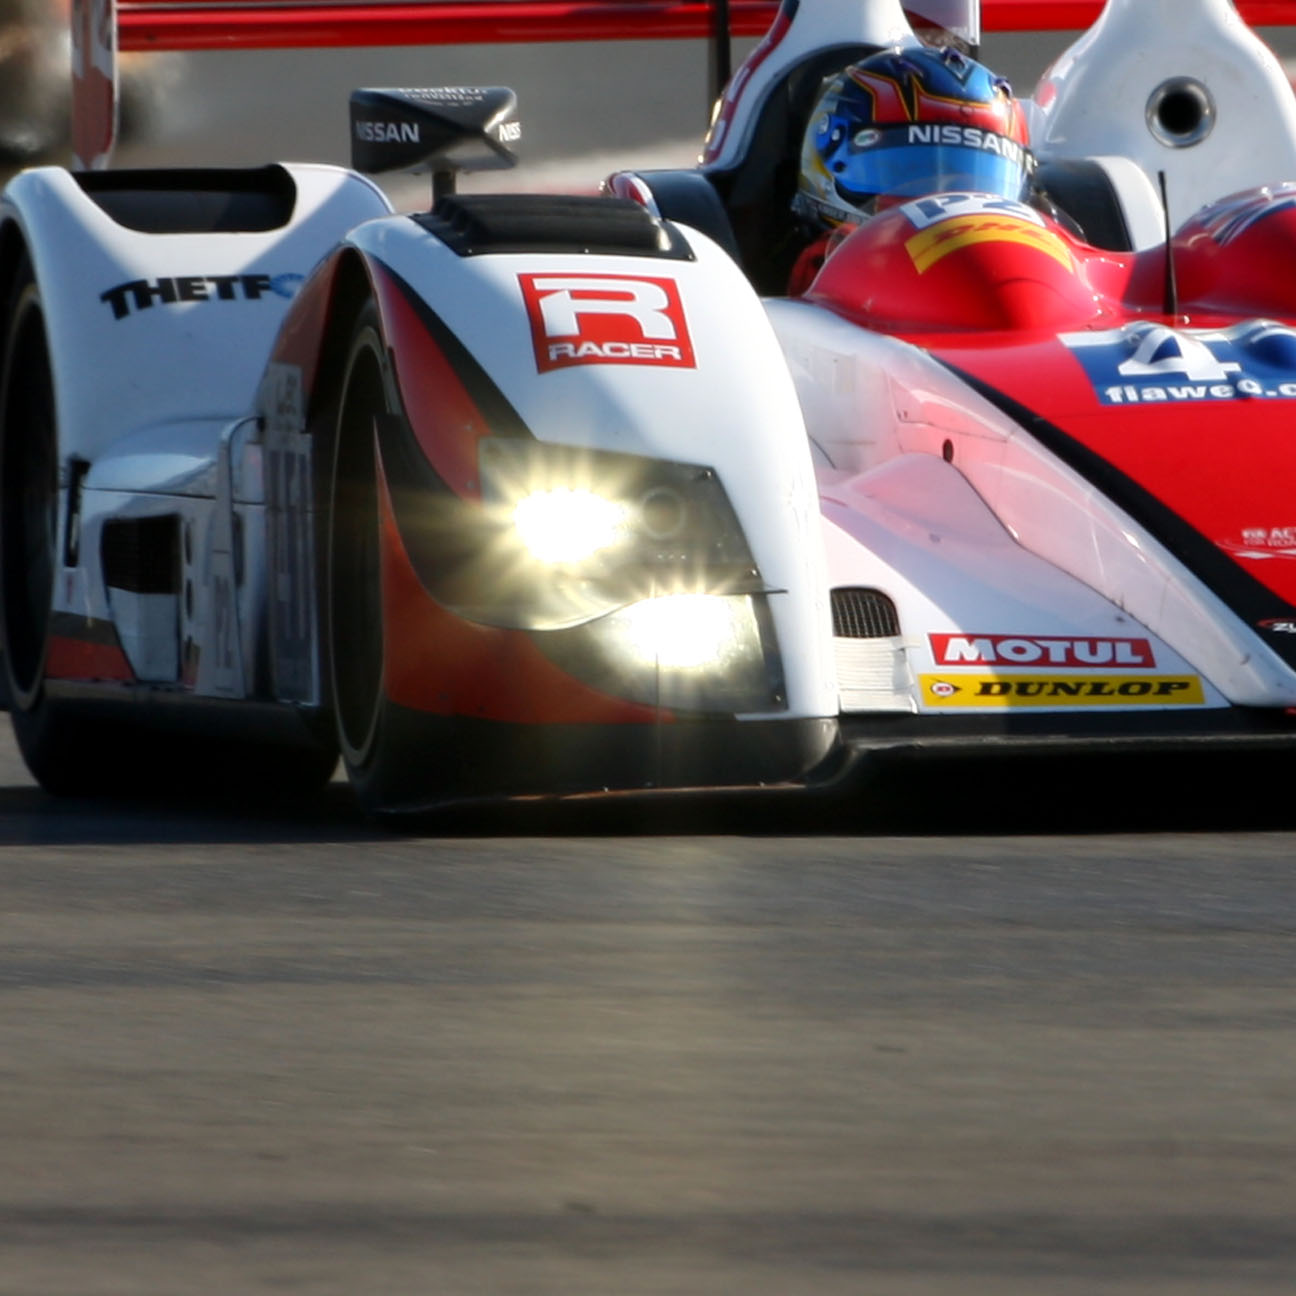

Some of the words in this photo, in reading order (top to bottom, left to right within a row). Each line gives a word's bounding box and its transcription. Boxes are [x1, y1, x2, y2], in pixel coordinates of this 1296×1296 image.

[908, 125, 1019, 162] NISSAN
[100, 274, 306, 321] THETFO
[532, 278, 678, 340] R
[548, 340, 683, 361] RACER
[944, 637, 1146, 664] MOTUL
[974, 680, 1191, 697] DUNLOP
